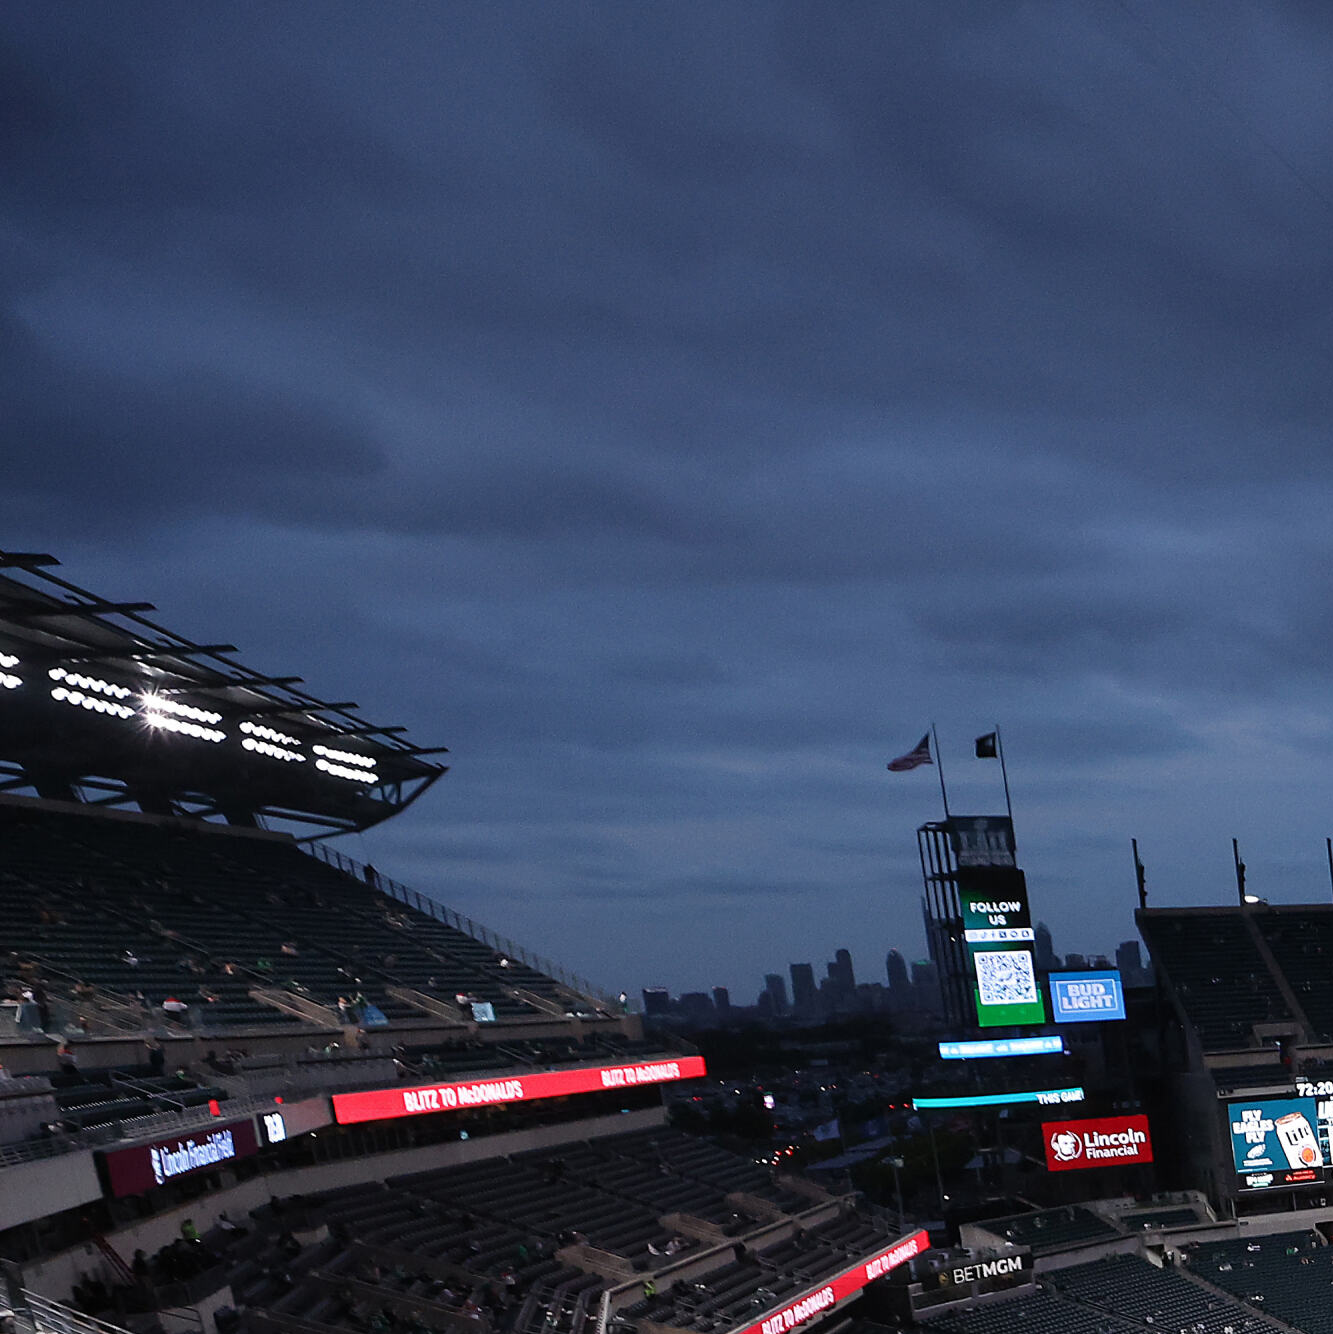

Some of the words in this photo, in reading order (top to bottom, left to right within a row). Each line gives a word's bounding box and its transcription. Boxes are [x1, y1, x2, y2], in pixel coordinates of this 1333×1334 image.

[969, 901, 1021, 915] FOLLOW
[988, 914, 1007, 926] US
[1067, 984, 1106, 997] BUD
[1062, 994, 1114, 1010] LIGHT
[601, 1067, 626, 1086] BLITZ
[625, 1066, 637, 1083] TO
[404, 1088, 441, 1112] BLITZ
[440, 1087, 457, 1107] TO
[1036, 1093, 1060, 1105] THIS
[1241, 1110, 1263, 1122] FLY
[1232, 1119, 1275, 1134] EAGLES
[1083, 1129, 1146, 1149] Lincoln
[1245, 1131, 1265, 1143] FLY
[1086, 1144, 1139, 1160] Financial
[953, 1257, 1023, 1284] BETMGM
[782, 1308, 795, 1328] TO
